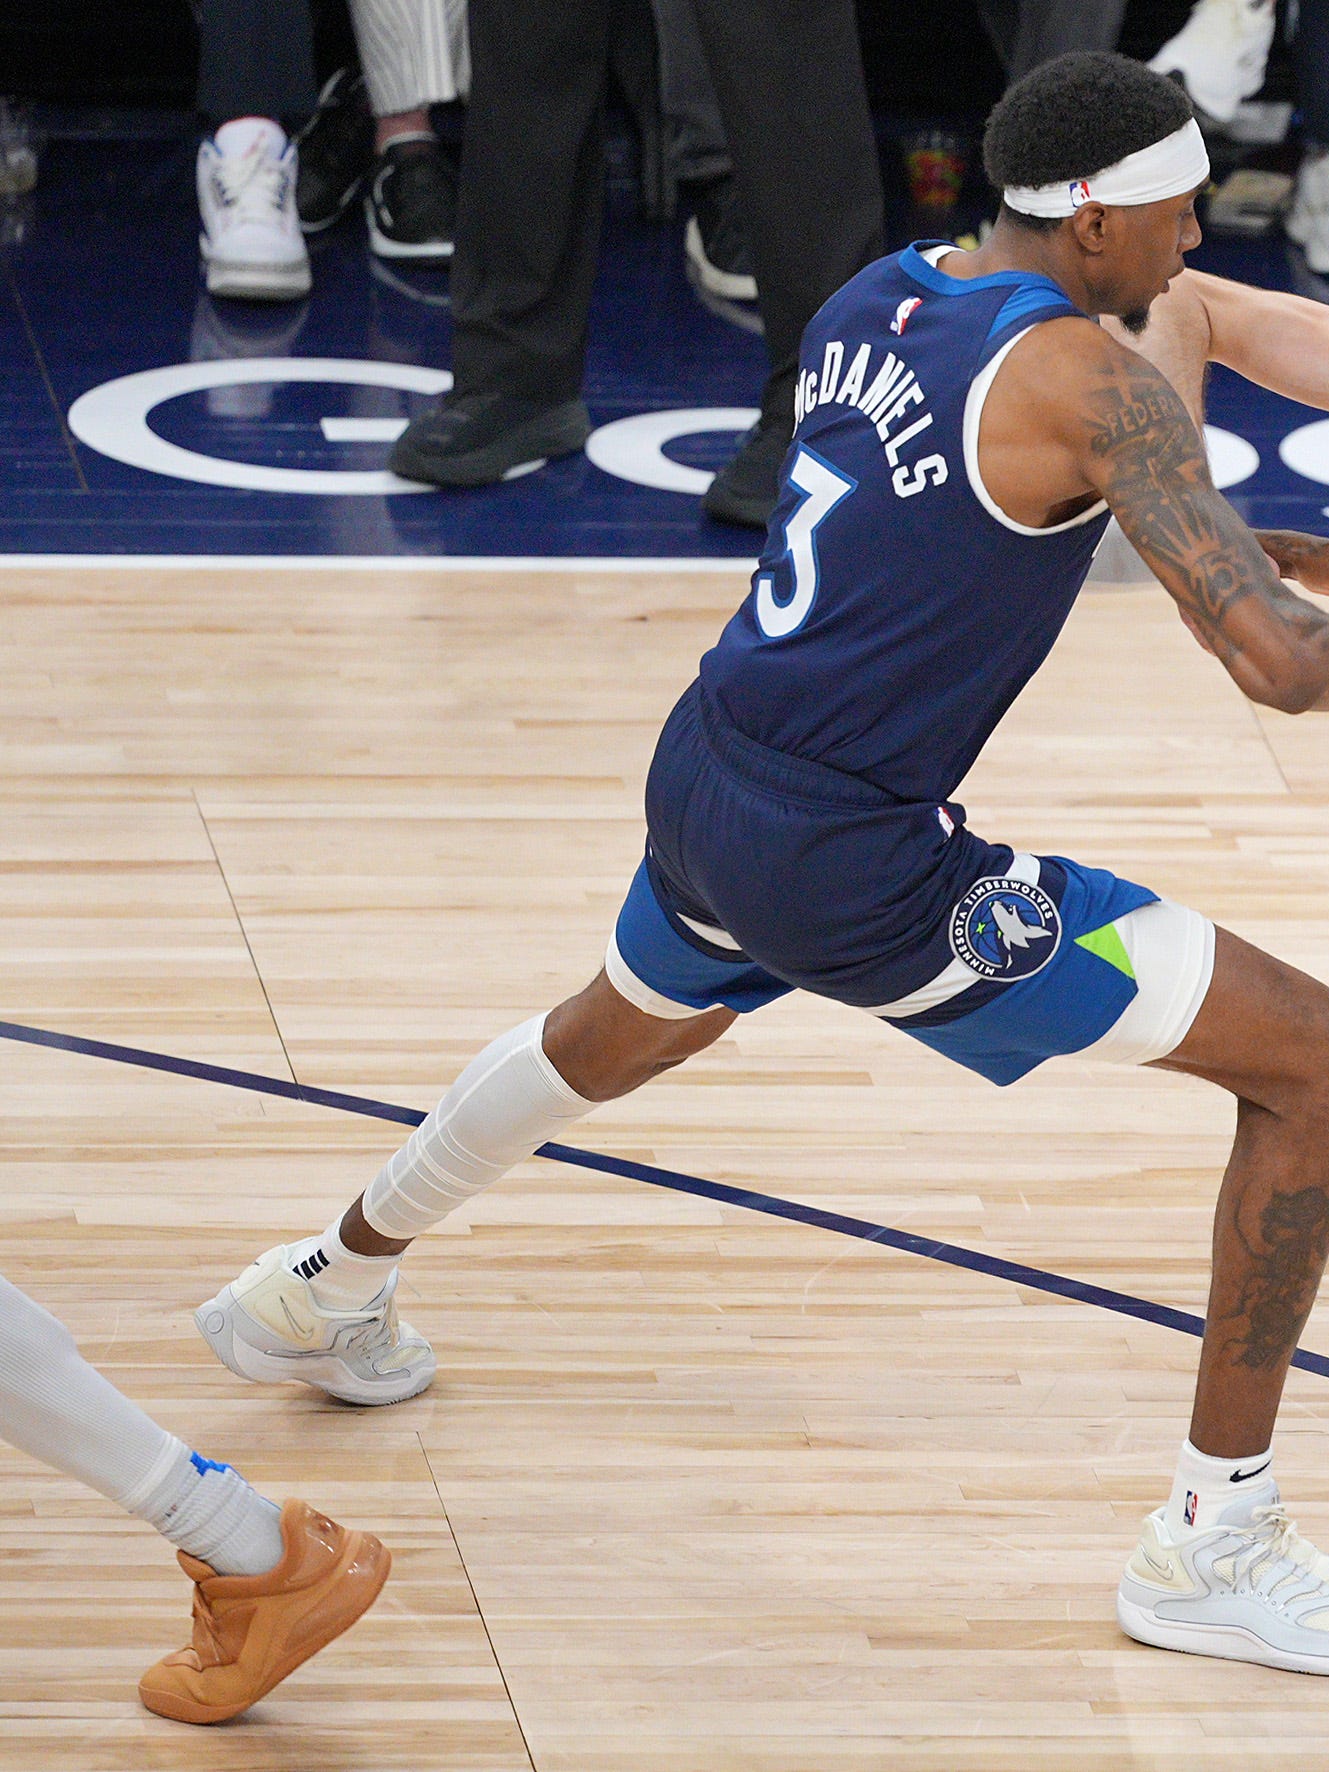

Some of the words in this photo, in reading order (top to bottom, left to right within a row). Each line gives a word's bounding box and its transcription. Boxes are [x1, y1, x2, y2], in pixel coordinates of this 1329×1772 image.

[753, 441, 858, 642] 3
[964, 879, 1054, 920] TIMBERWOLVES
[954, 911, 996, 977] MINNESOTA
